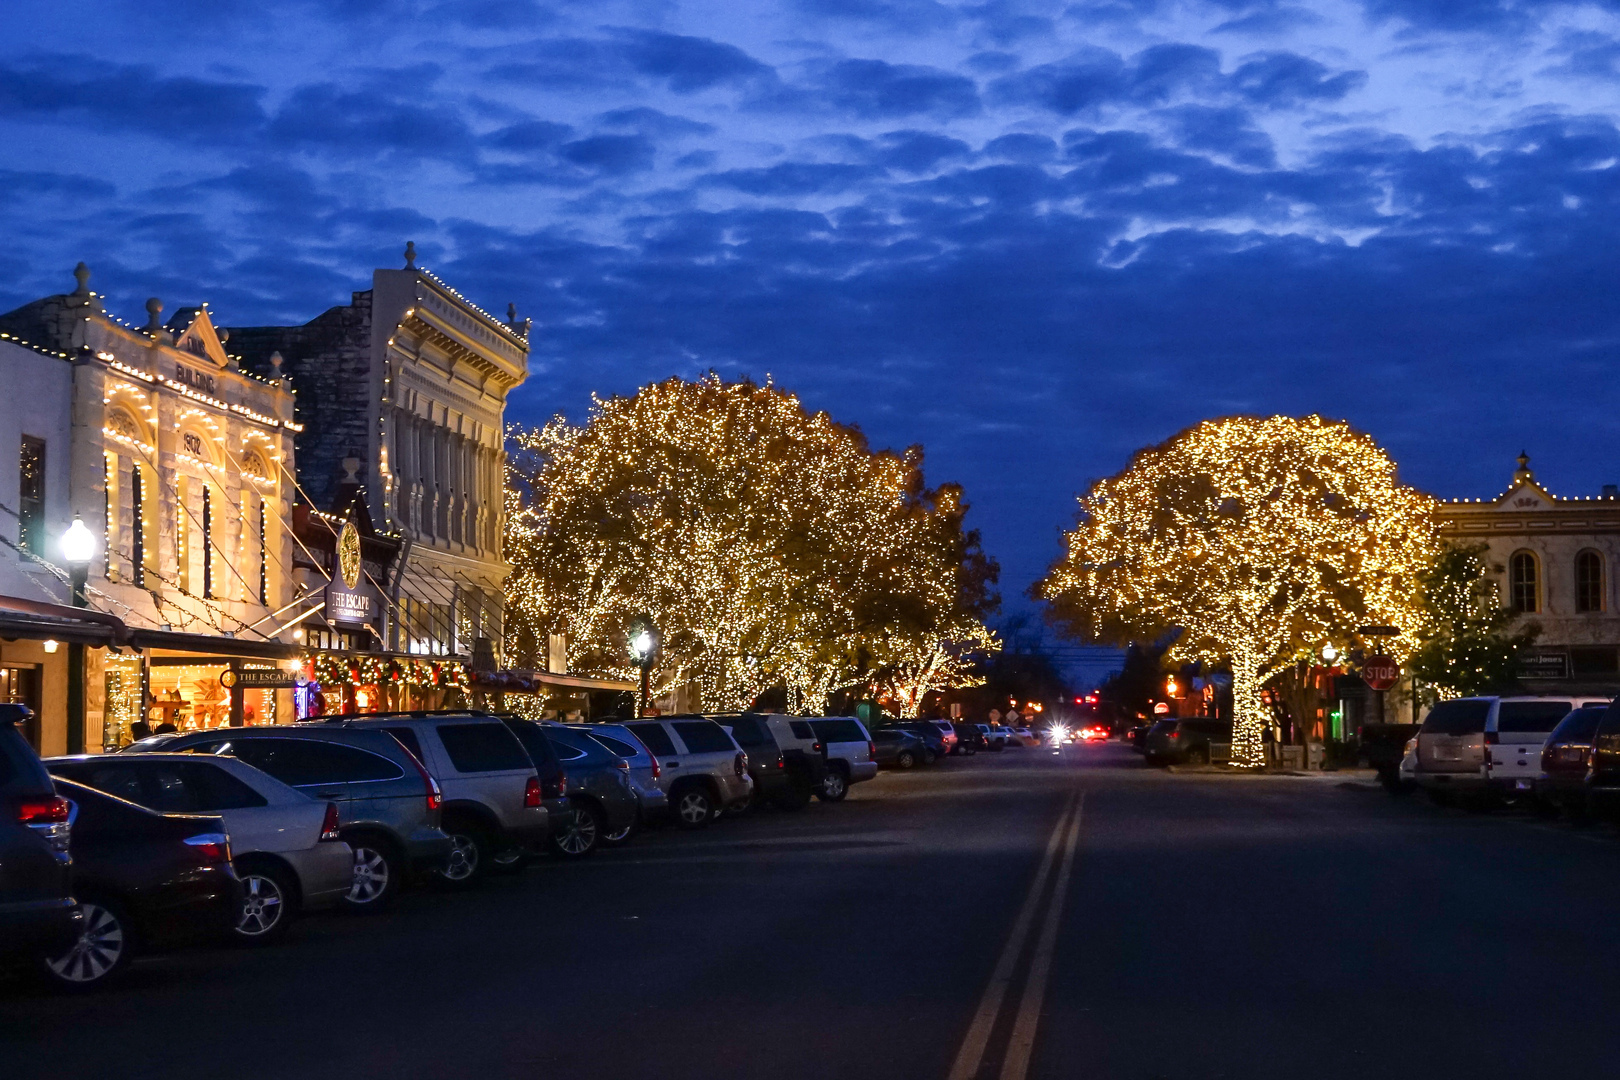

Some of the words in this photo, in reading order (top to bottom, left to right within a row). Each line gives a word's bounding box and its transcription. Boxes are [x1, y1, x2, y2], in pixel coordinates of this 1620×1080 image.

[177, 366, 214, 394] BUILDING
[332, 592, 345, 607] THE
[346, 594, 369, 610] ESCAPE
[1538, 655, 1563, 664] Jones
[239, 673, 257, 681] THE
[259, 673, 294, 681] ESCAPE
[1366, 666, 1395, 680] STOP
